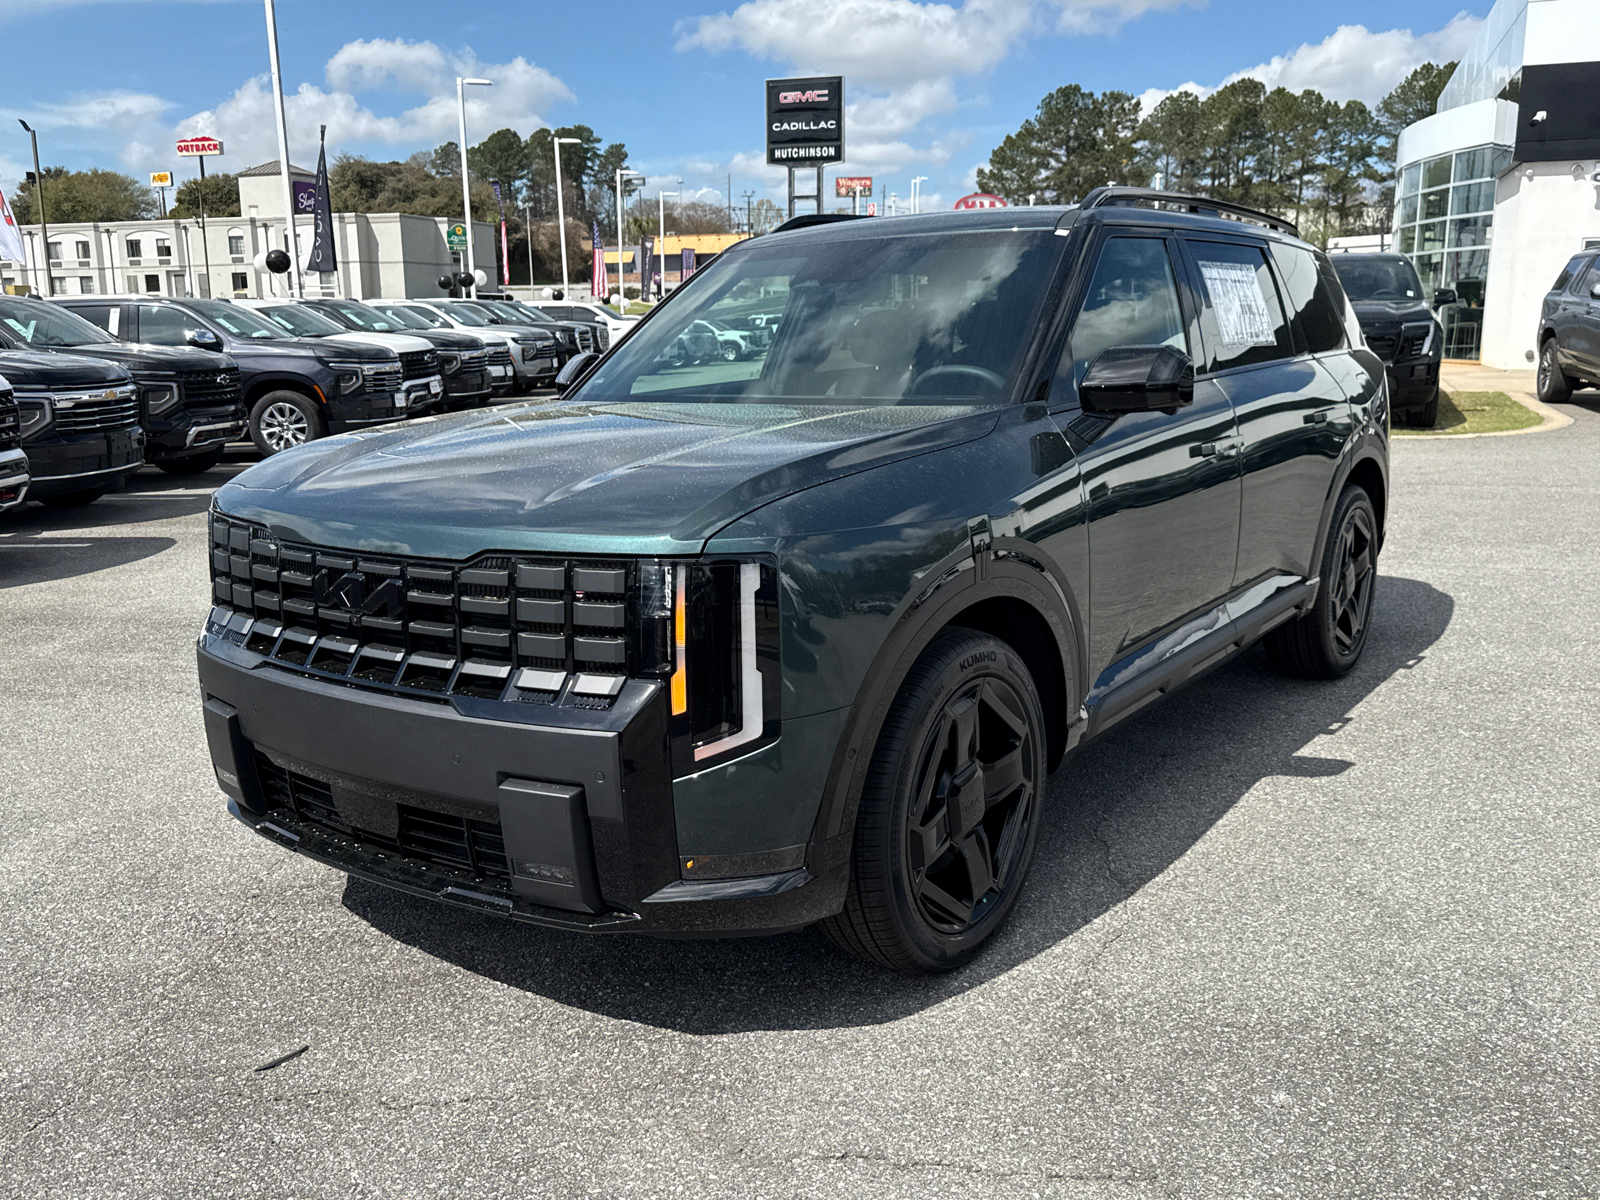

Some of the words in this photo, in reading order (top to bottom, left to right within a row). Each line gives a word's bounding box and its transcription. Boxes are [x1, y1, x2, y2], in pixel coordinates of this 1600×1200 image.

[779, 89, 828, 104] GMC
[772, 120, 836, 131] CADILLAC
[177, 143, 219, 153] OUTBACK
[774, 146, 835, 159] HUTCHINSON
[959, 650, 997, 672] KUMHO
